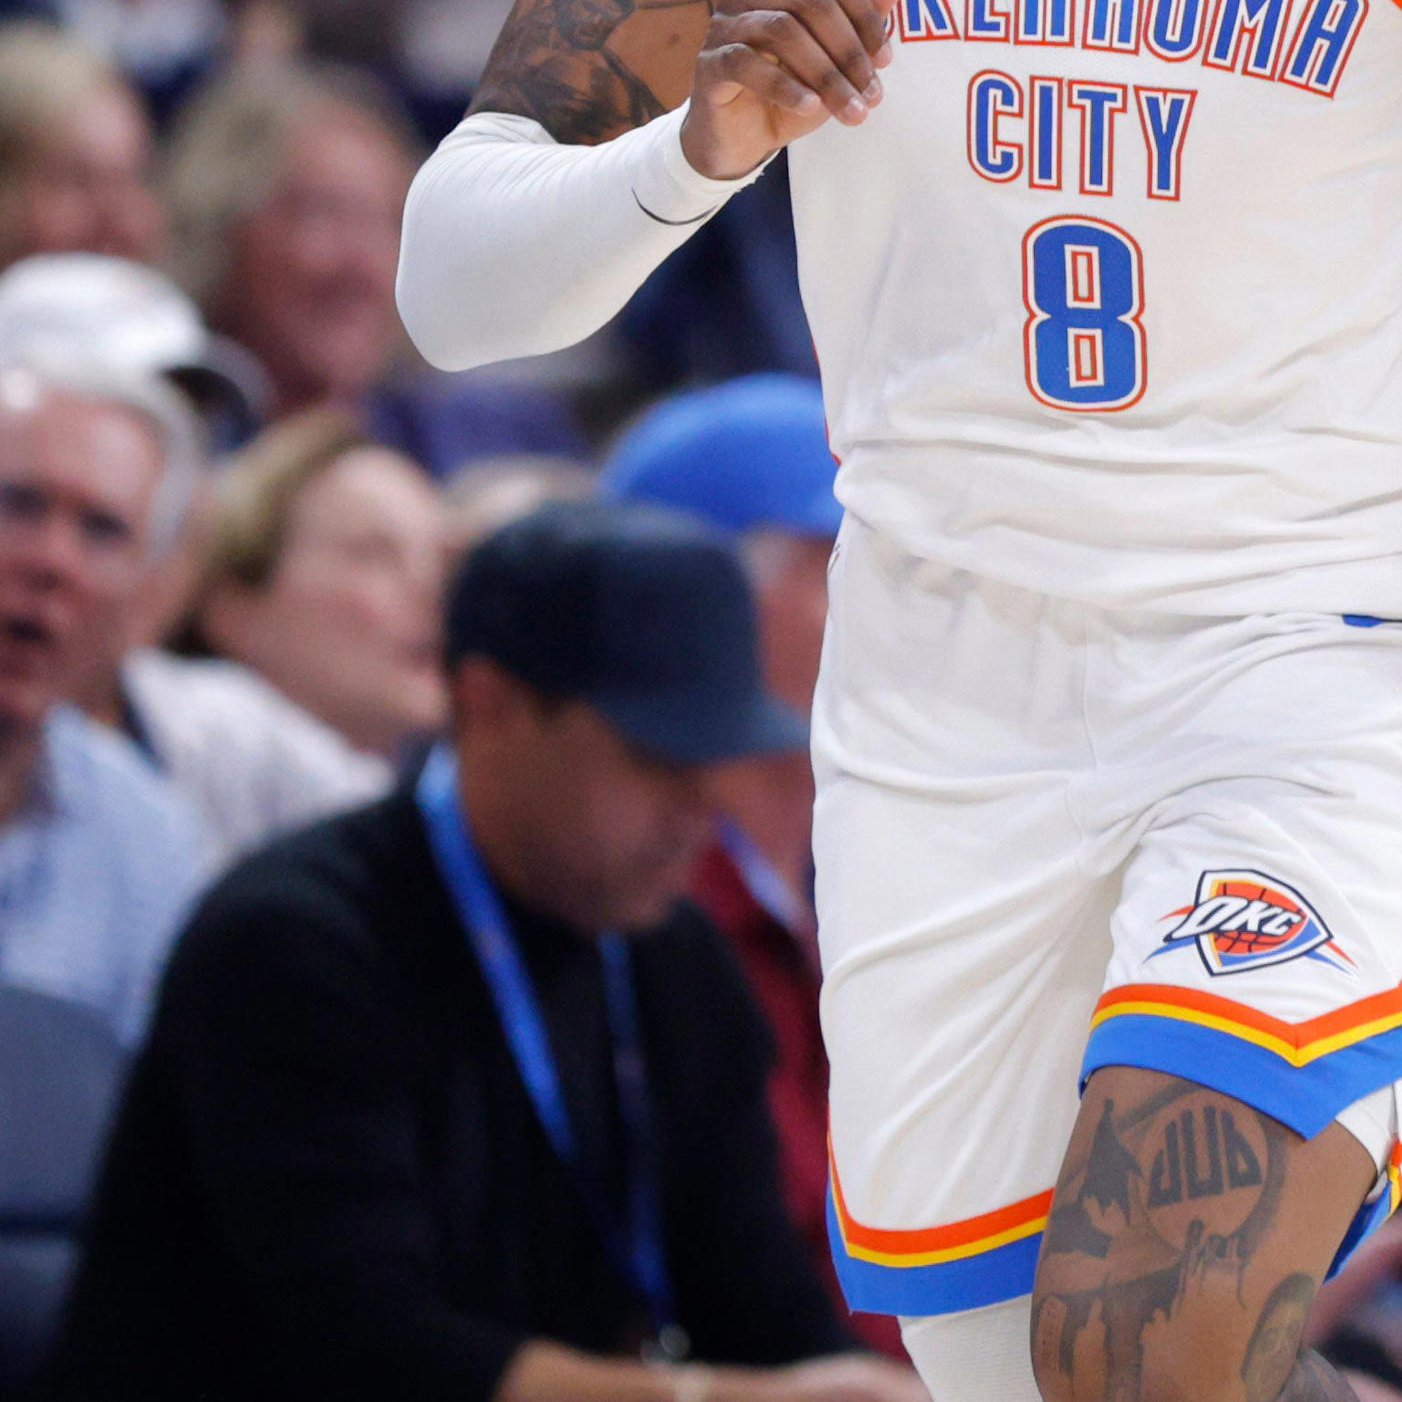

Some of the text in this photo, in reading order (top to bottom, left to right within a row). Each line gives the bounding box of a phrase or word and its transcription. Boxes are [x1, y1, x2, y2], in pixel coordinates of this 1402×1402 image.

[966, 69, 1197, 201] CITY
[1022, 213, 1147, 412] 8
[1165, 894, 1305, 942] OKC
